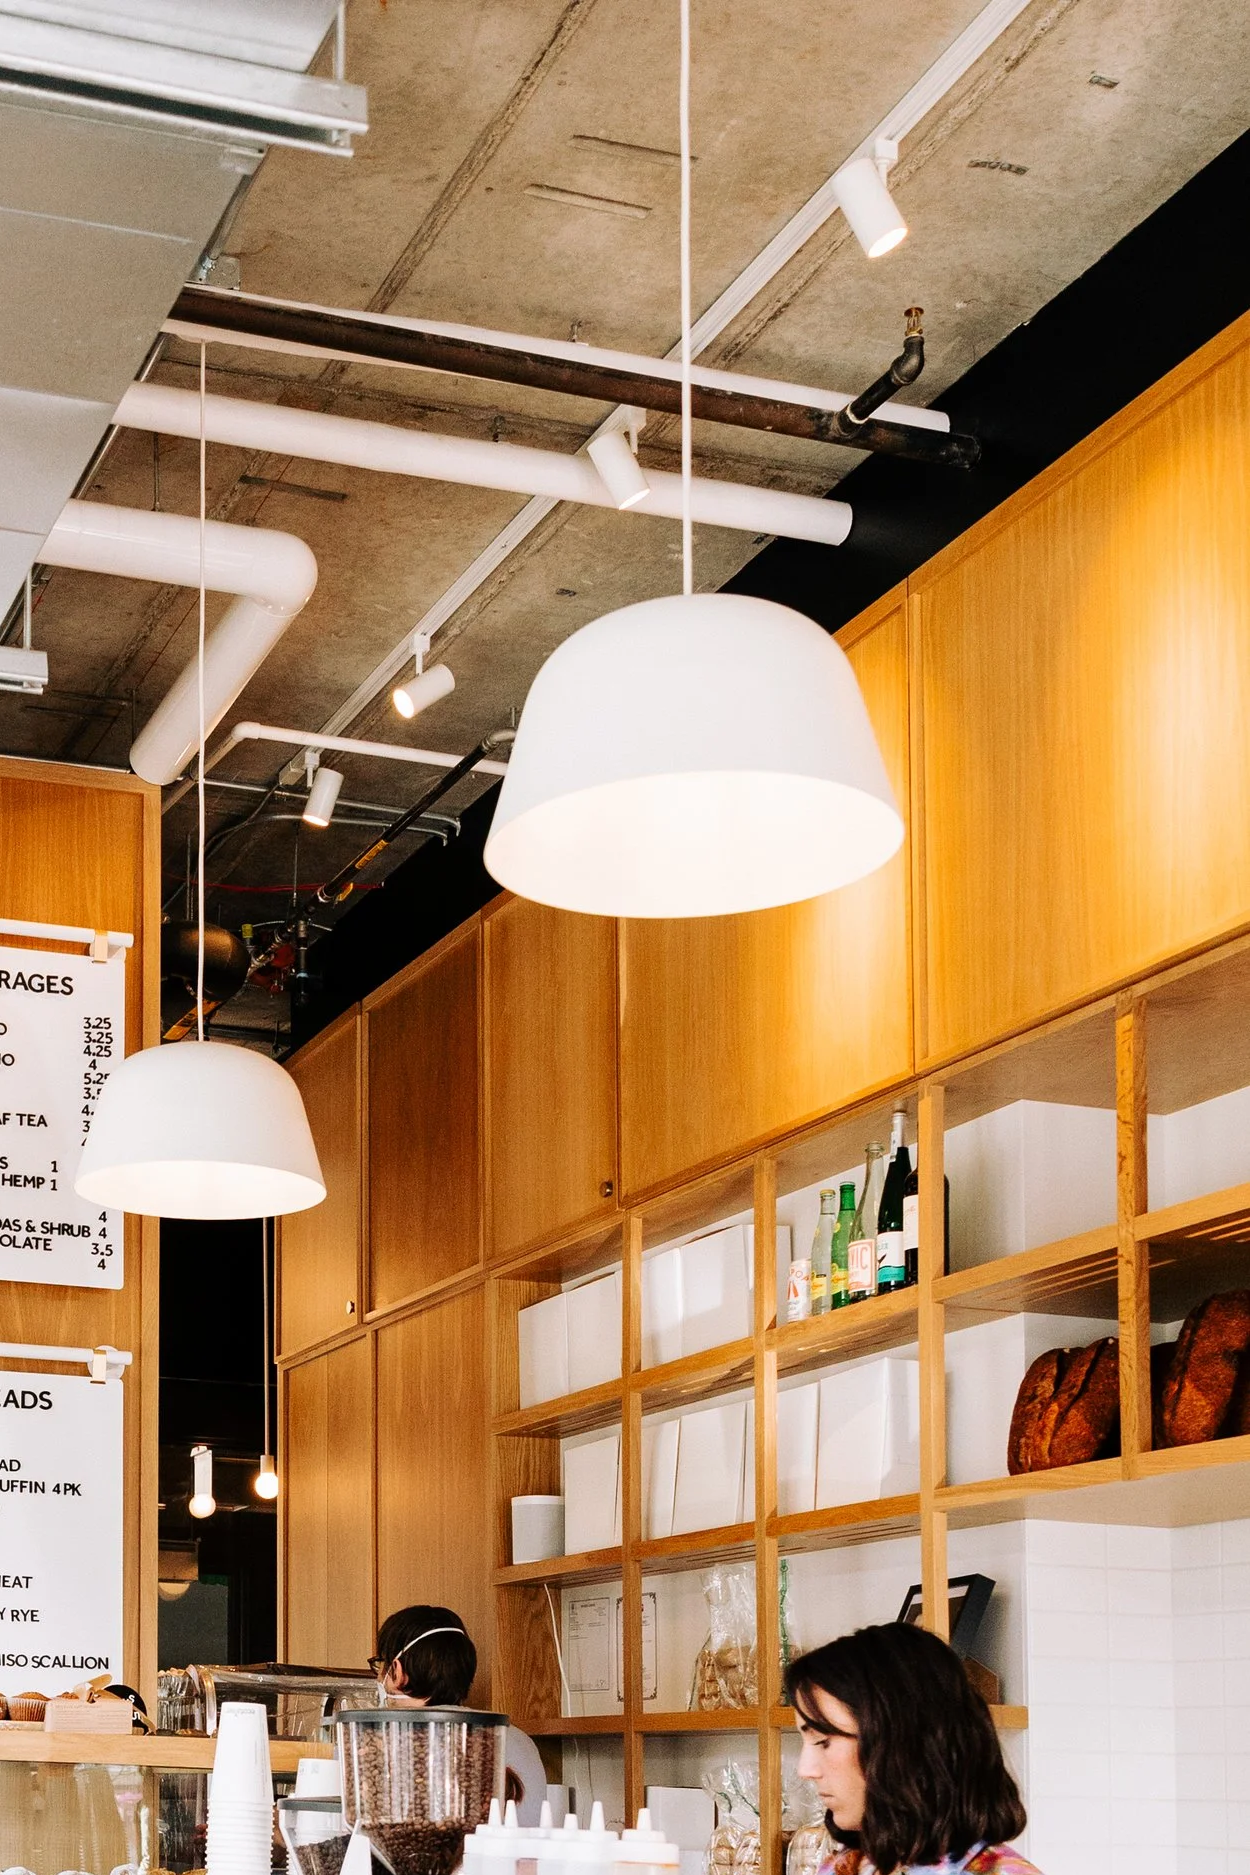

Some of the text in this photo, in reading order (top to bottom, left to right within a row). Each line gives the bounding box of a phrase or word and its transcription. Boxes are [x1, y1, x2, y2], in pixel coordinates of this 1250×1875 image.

[84, 1017, 111, 1030] 3.25
[84, 1031, 113, 1044] 3.25
[84, 1045, 112, 1058] 4.25
[88, 1059, 97, 1070] 4
[16, 1113, 48, 1127] TEA
[51, 1161, 58, 1172] 1
[2, 1173, 45, 1189] HEMP
[50, 1179, 57, 1191] 1
[98, 1211, 107, 1222] 4
[41, 1221, 90, 1238] SHRUB
[98, 1227, 107, 1239] 4
[91, 1243, 113, 1256] 3.5
[98, 1259, 106, 1270] 4
[11, 1610, 39, 1622] RYE
[32, 1655, 108, 1669] SCALLION
